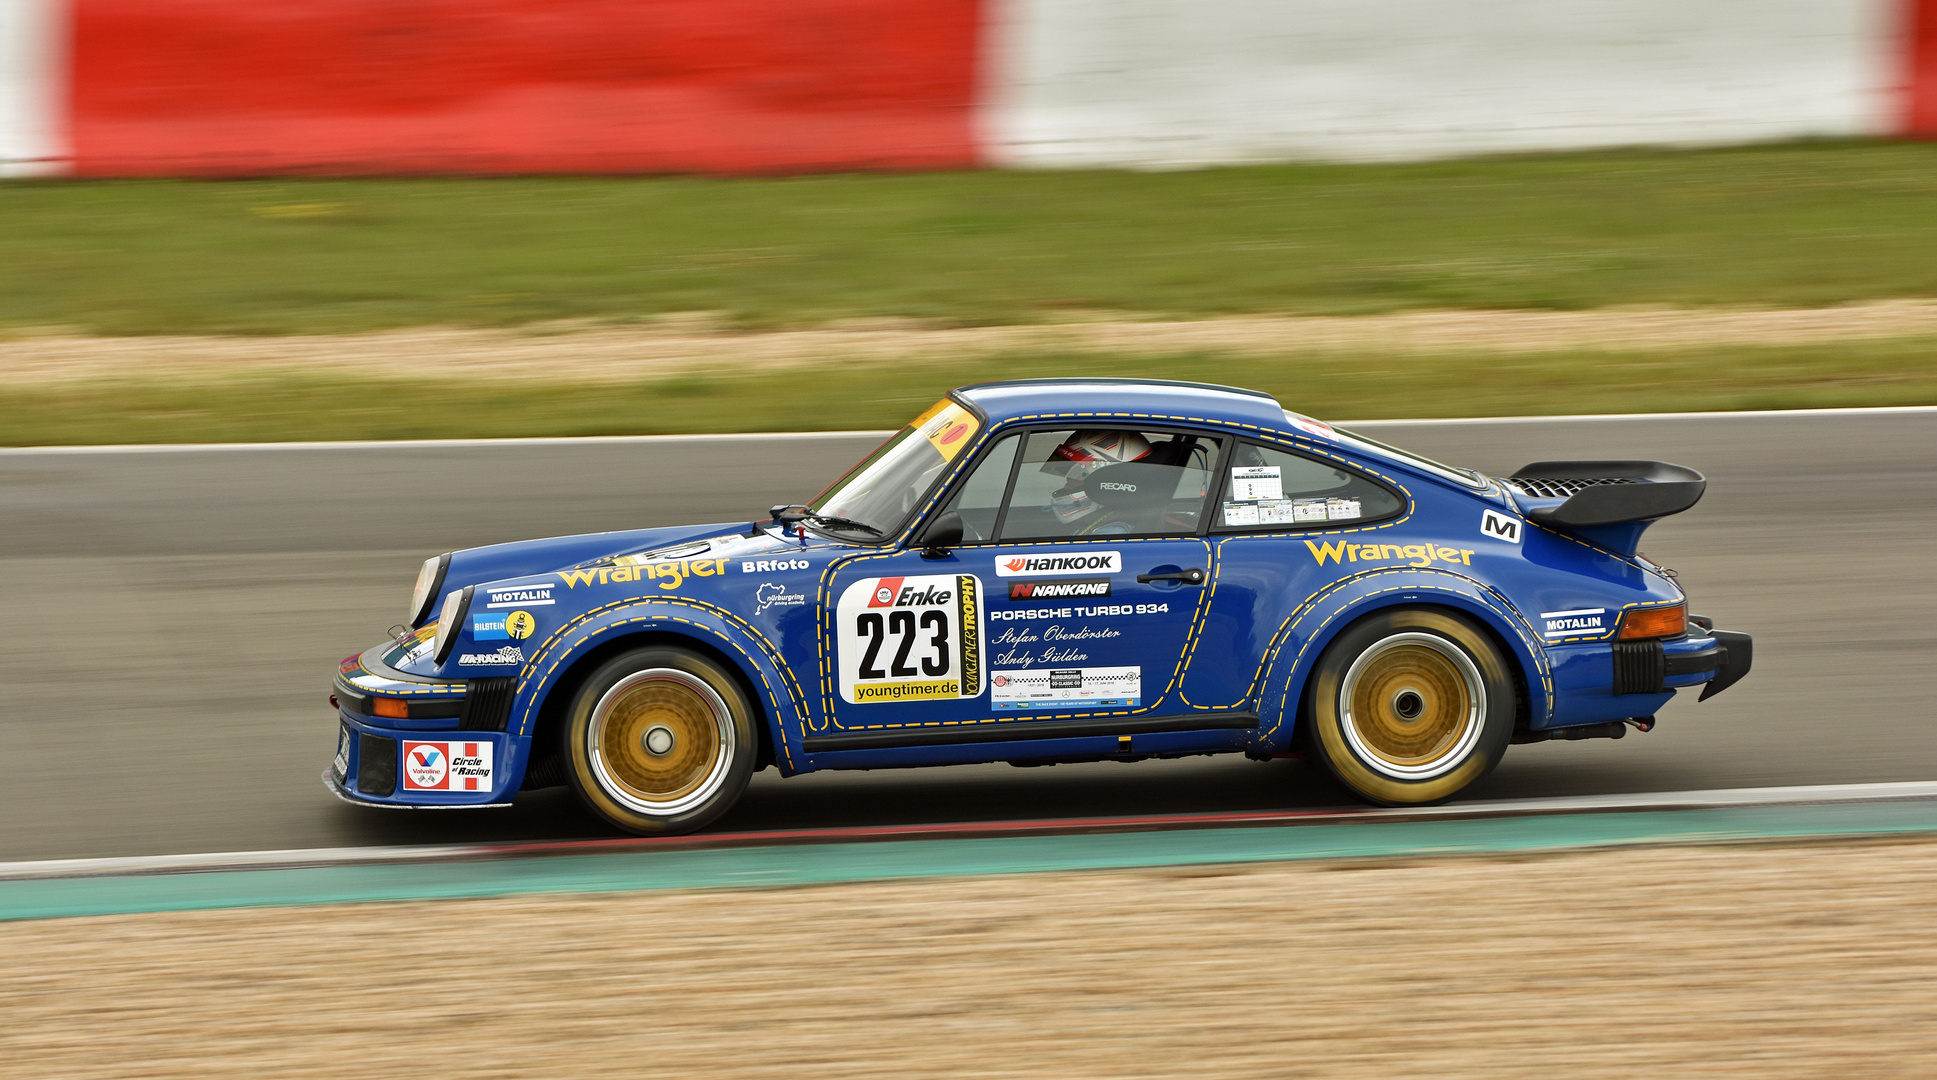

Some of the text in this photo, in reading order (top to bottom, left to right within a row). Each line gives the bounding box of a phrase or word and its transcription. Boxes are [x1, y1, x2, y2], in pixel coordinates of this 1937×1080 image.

[1100, 482, 1137, 493] RECARO
[1485, 514, 1517, 539] M
[1303, 540, 1475, 568] Wrangler
[557, 558, 731, 590] Wrangler
[742, 559, 810, 573] BRfoto
[492, 590, 550, 602] MOTALIN
[895, 585, 952, 607] Enke
[1032, 583, 1110, 597] NANKANG
[990, 603, 1169, 621] PORSCHE TURBO 934
[474, 622, 505, 631] BILSTEIN
[1546, 616, 1601, 630] MOTALIN
[856, 610, 949, 680] 223
[991, 625, 1121, 648] Stefan Oberdörster
[994, 646, 1088, 669] Andy Gülden
[858, 682, 959, 699] youngtimer.de
[452, 758, 482, 766] Circle
[458, 767, 490, 777] Racing
